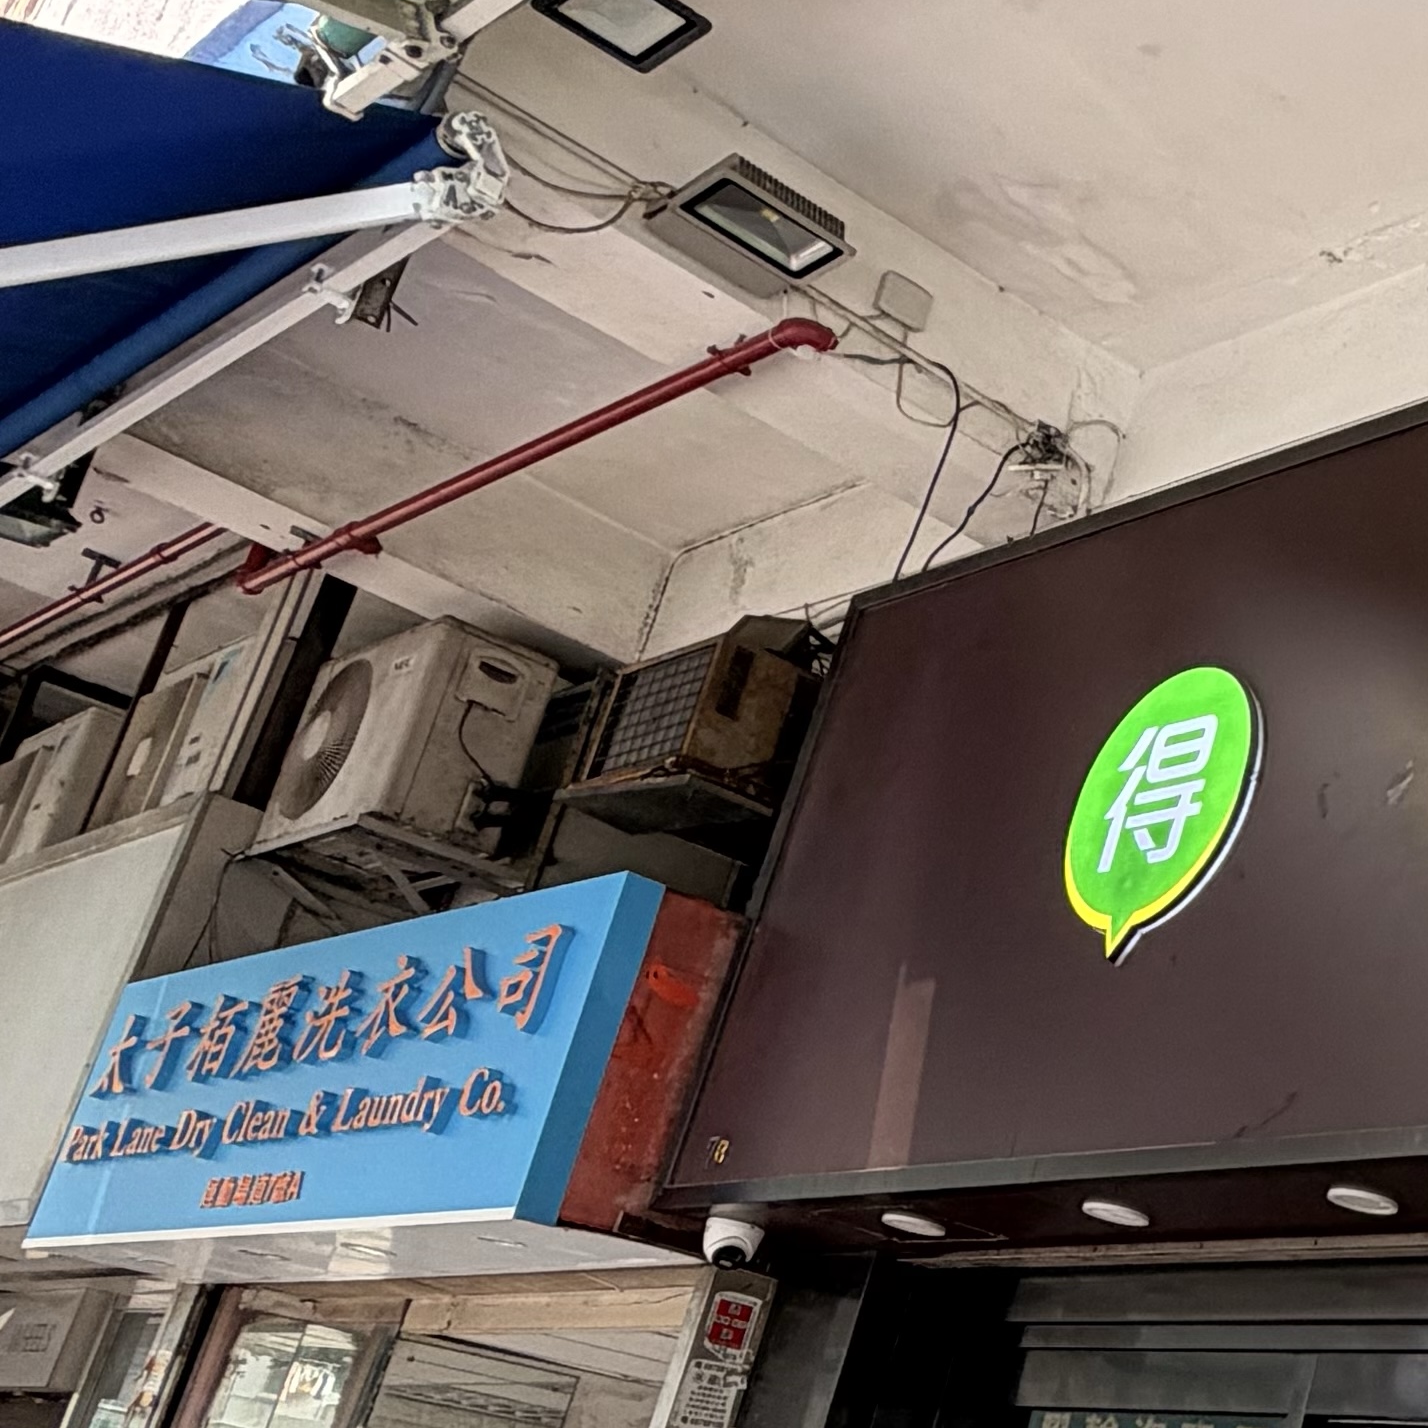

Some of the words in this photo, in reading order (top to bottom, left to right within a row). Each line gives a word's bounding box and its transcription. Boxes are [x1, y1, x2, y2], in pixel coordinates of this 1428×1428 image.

[62, 1125, 106, 1162] Park
[111, 1123, 162, 1157] Lane
[170, 1110, 216, 1158] Dry
[221, 1100, 288, 1145] Clean
[298, 1091, 326, 1135] &
[332, 1076, 450, 1133] Laundry
[459, 1067, 505, 1116] Co.
